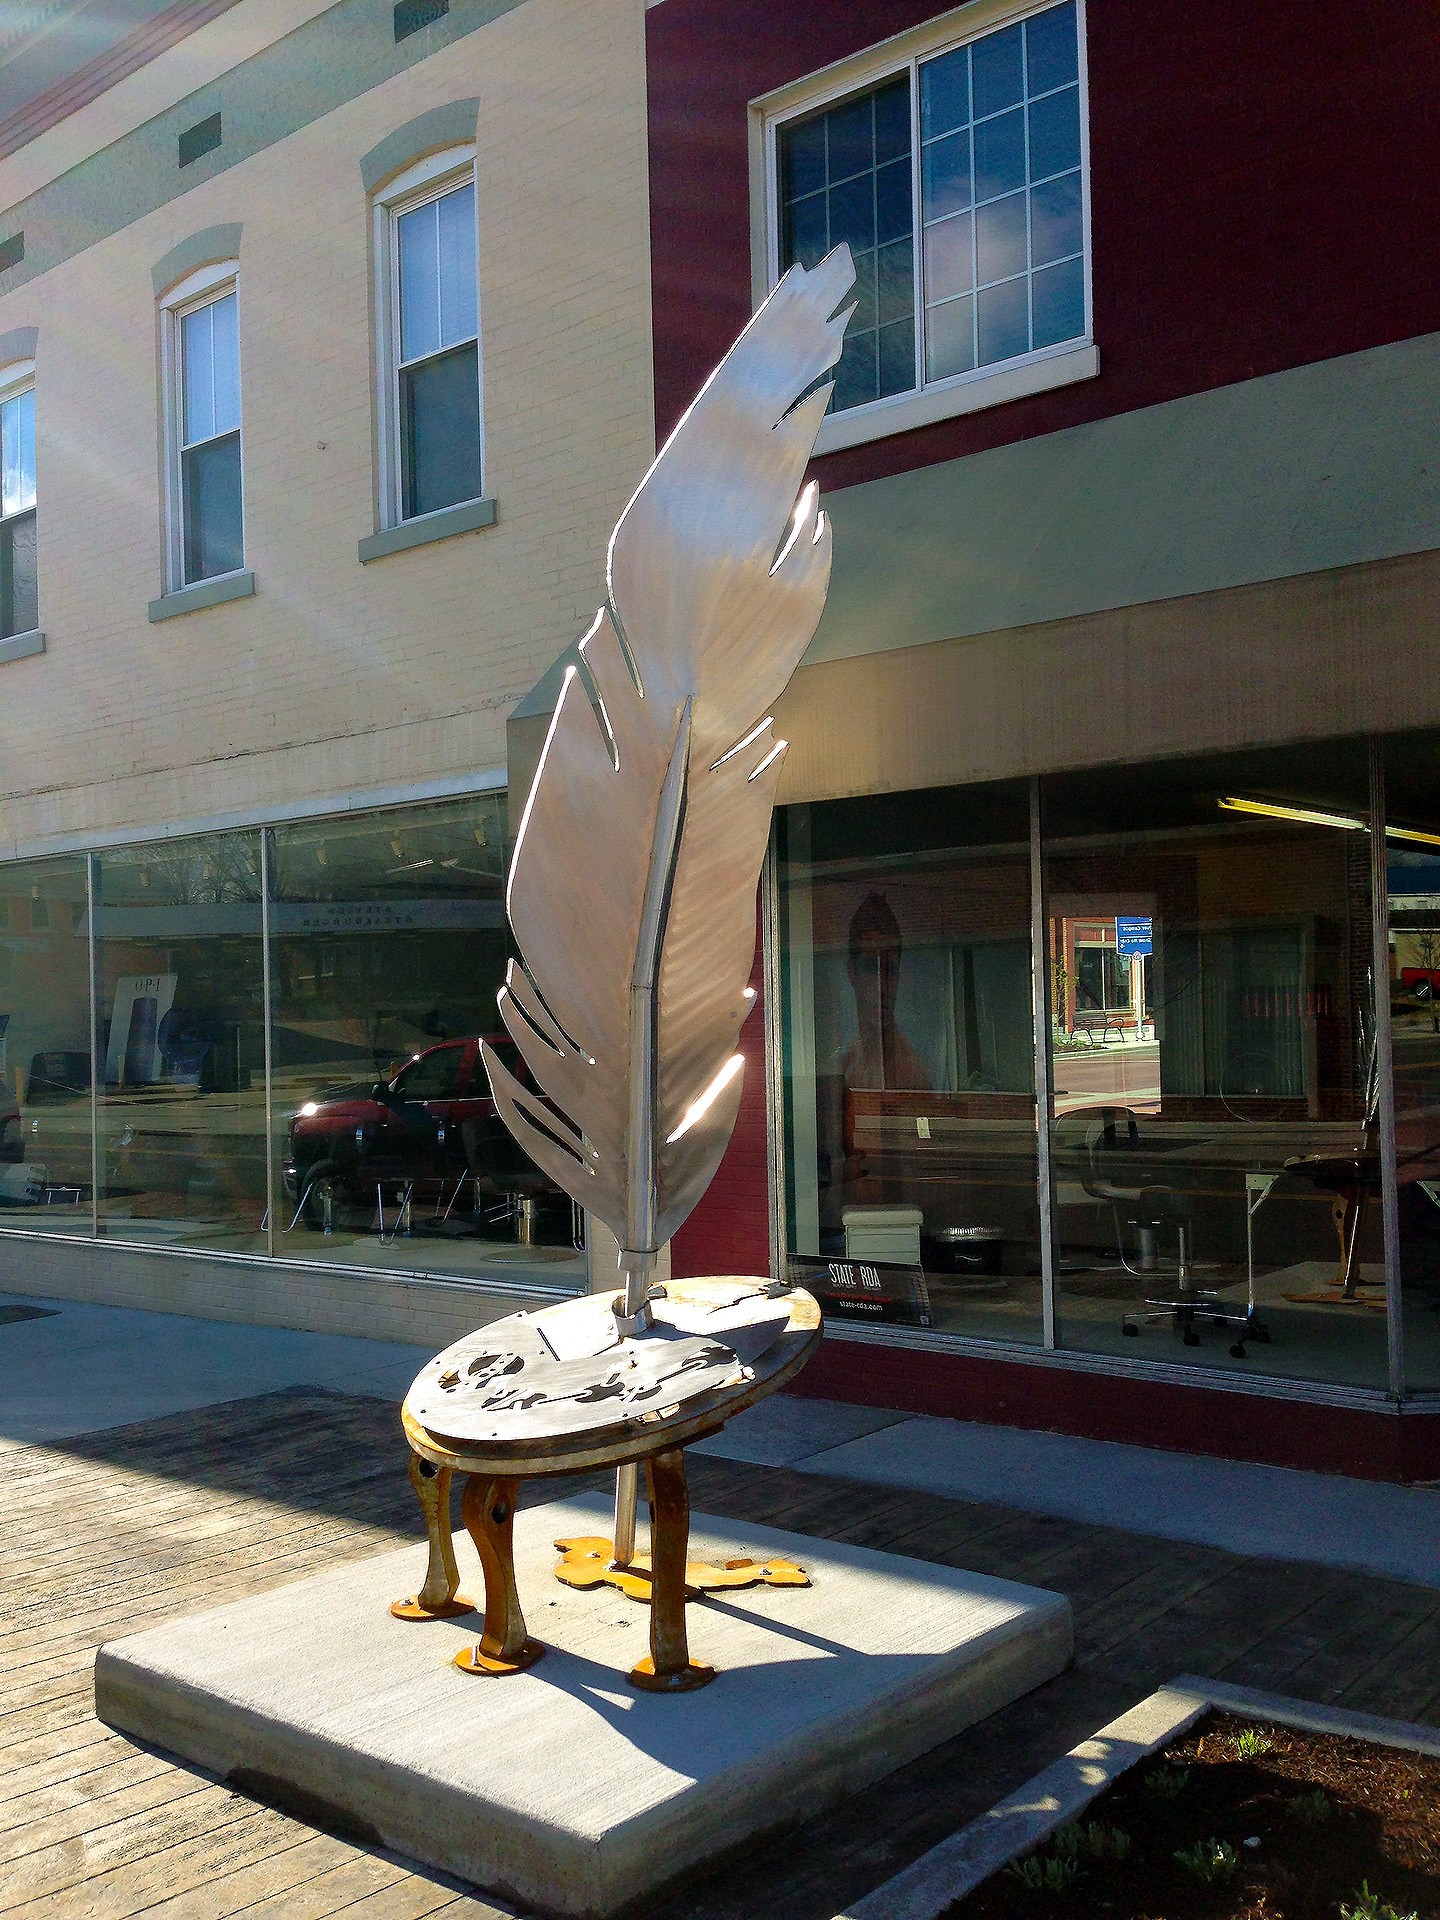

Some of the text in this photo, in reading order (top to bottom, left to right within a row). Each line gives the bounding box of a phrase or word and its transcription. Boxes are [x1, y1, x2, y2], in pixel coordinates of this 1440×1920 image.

[828, 1263, 882, 1287] STATE RDA
[839, 1301, 883, 1310] state-rda.com
